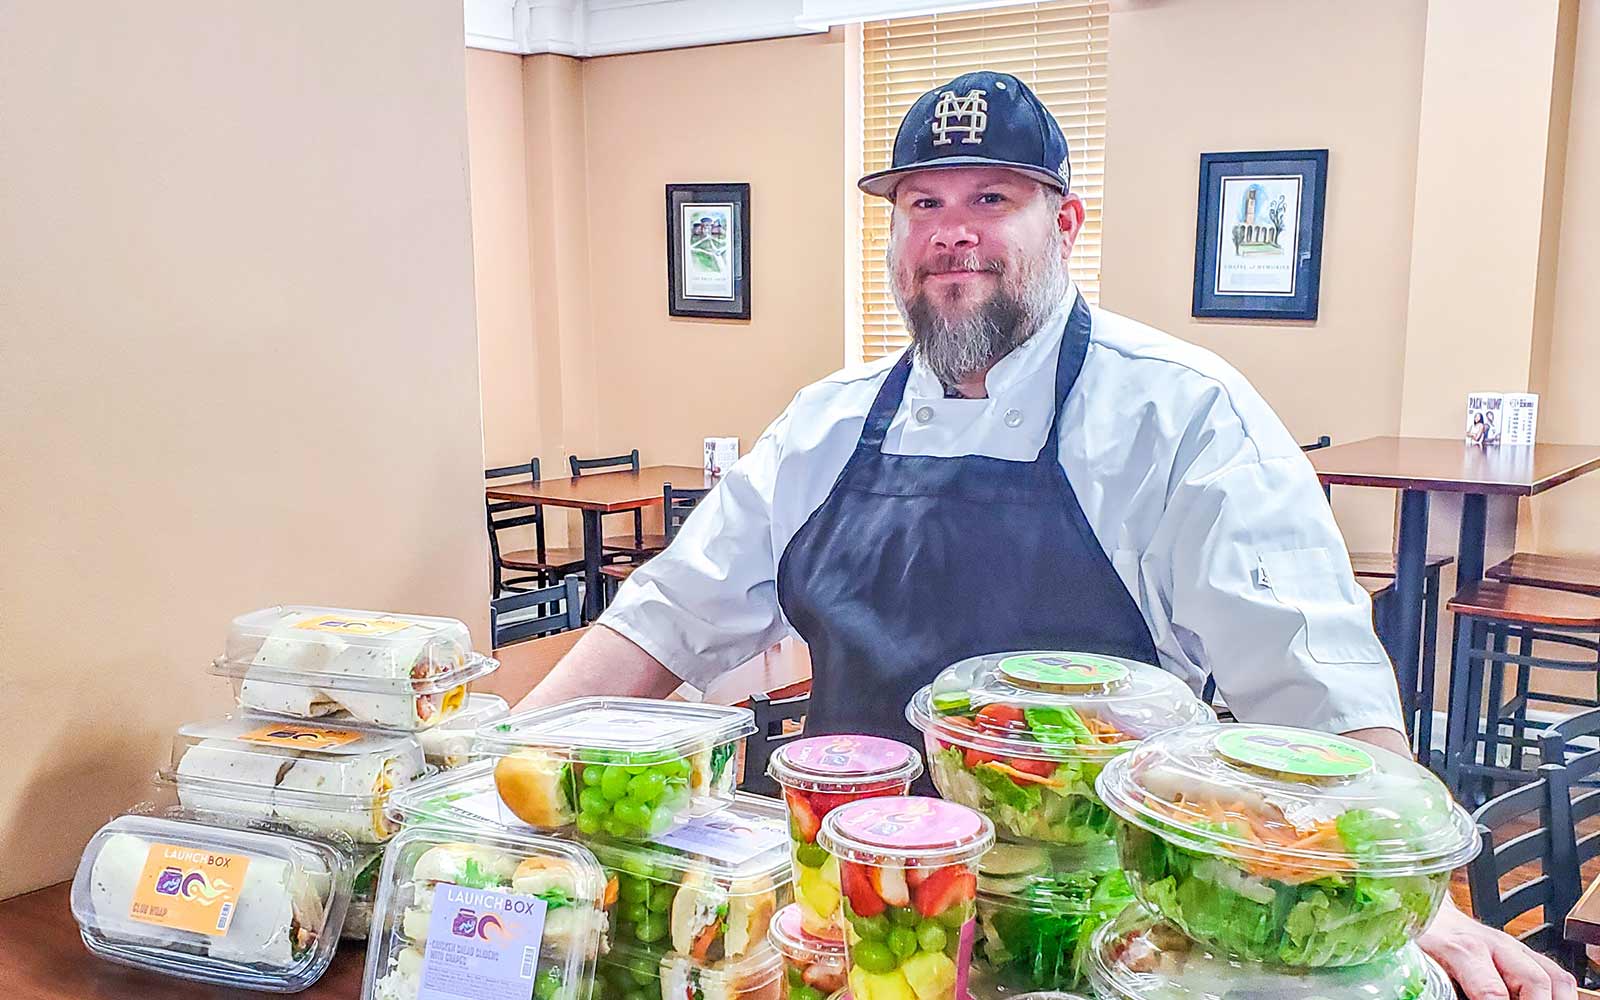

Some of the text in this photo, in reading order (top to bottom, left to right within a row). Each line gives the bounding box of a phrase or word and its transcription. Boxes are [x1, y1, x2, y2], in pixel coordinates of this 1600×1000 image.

[1469, 397, 1483, 410] PACK
[164, 848, 232, 869] LAUNCHBOX
[447, 889, 535, 916] LAUNCHBOX
